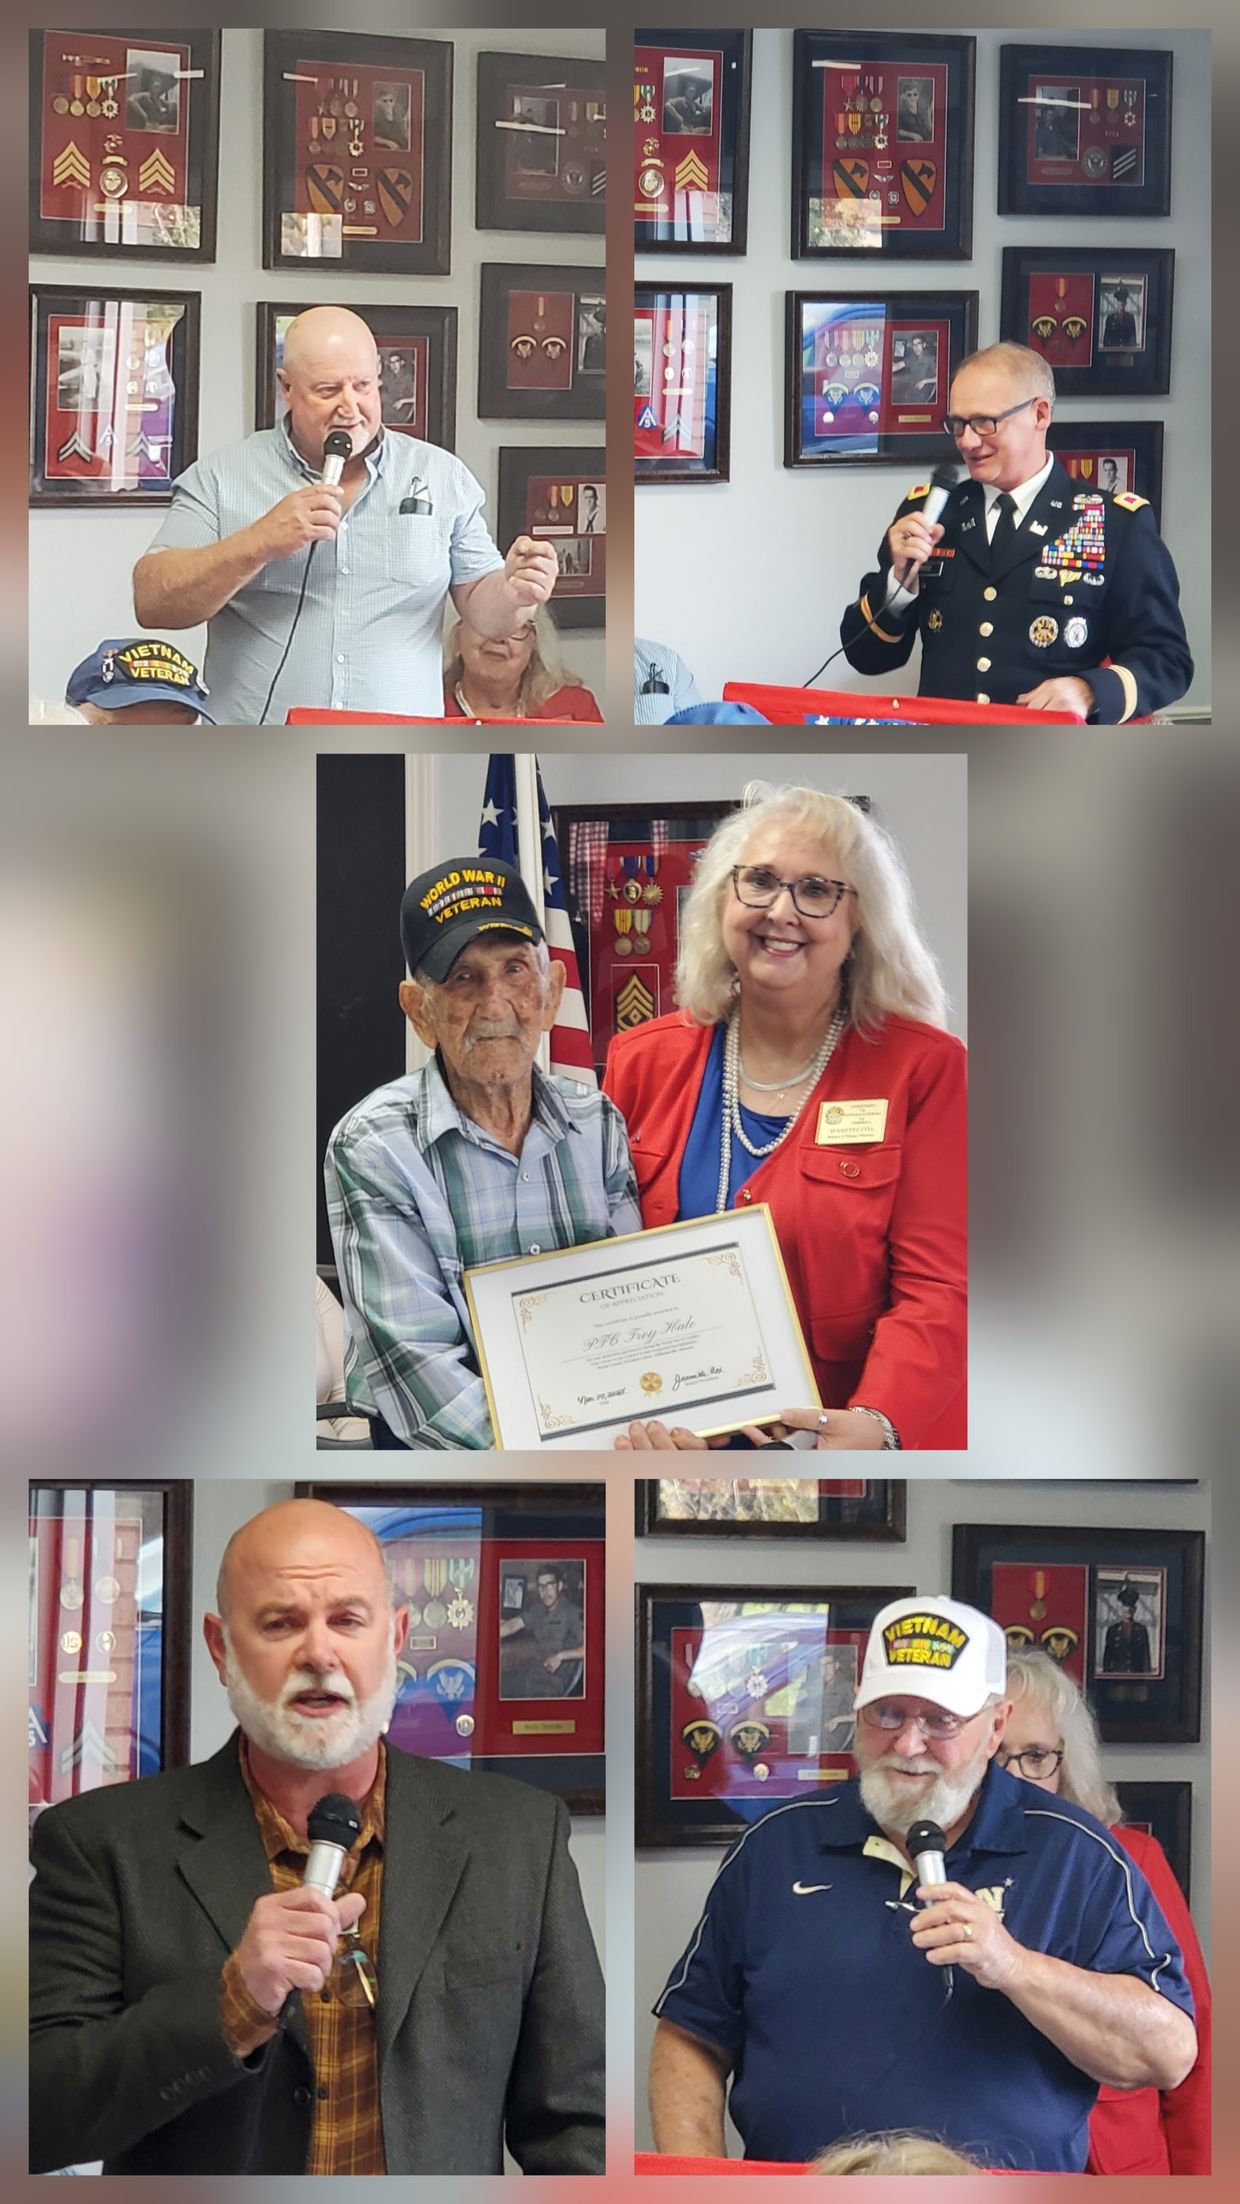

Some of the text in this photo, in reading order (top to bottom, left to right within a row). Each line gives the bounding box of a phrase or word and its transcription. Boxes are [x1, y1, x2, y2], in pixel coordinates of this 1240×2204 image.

[118, 644, 194, 675] VIETNAM
[130, 667, 191, 686] VETERAN
[419, 868, 506, 910] WORLD WAR II
[435, 896, 502, 924] VETERAN
[579, 1273, 681, 1304] CERTIFICATE
[624, 1327, 657, 1345] Troy
[884, 1615, 967, 1649] VIETNAM
[888, 1647, 952, 1668] VETERAN
